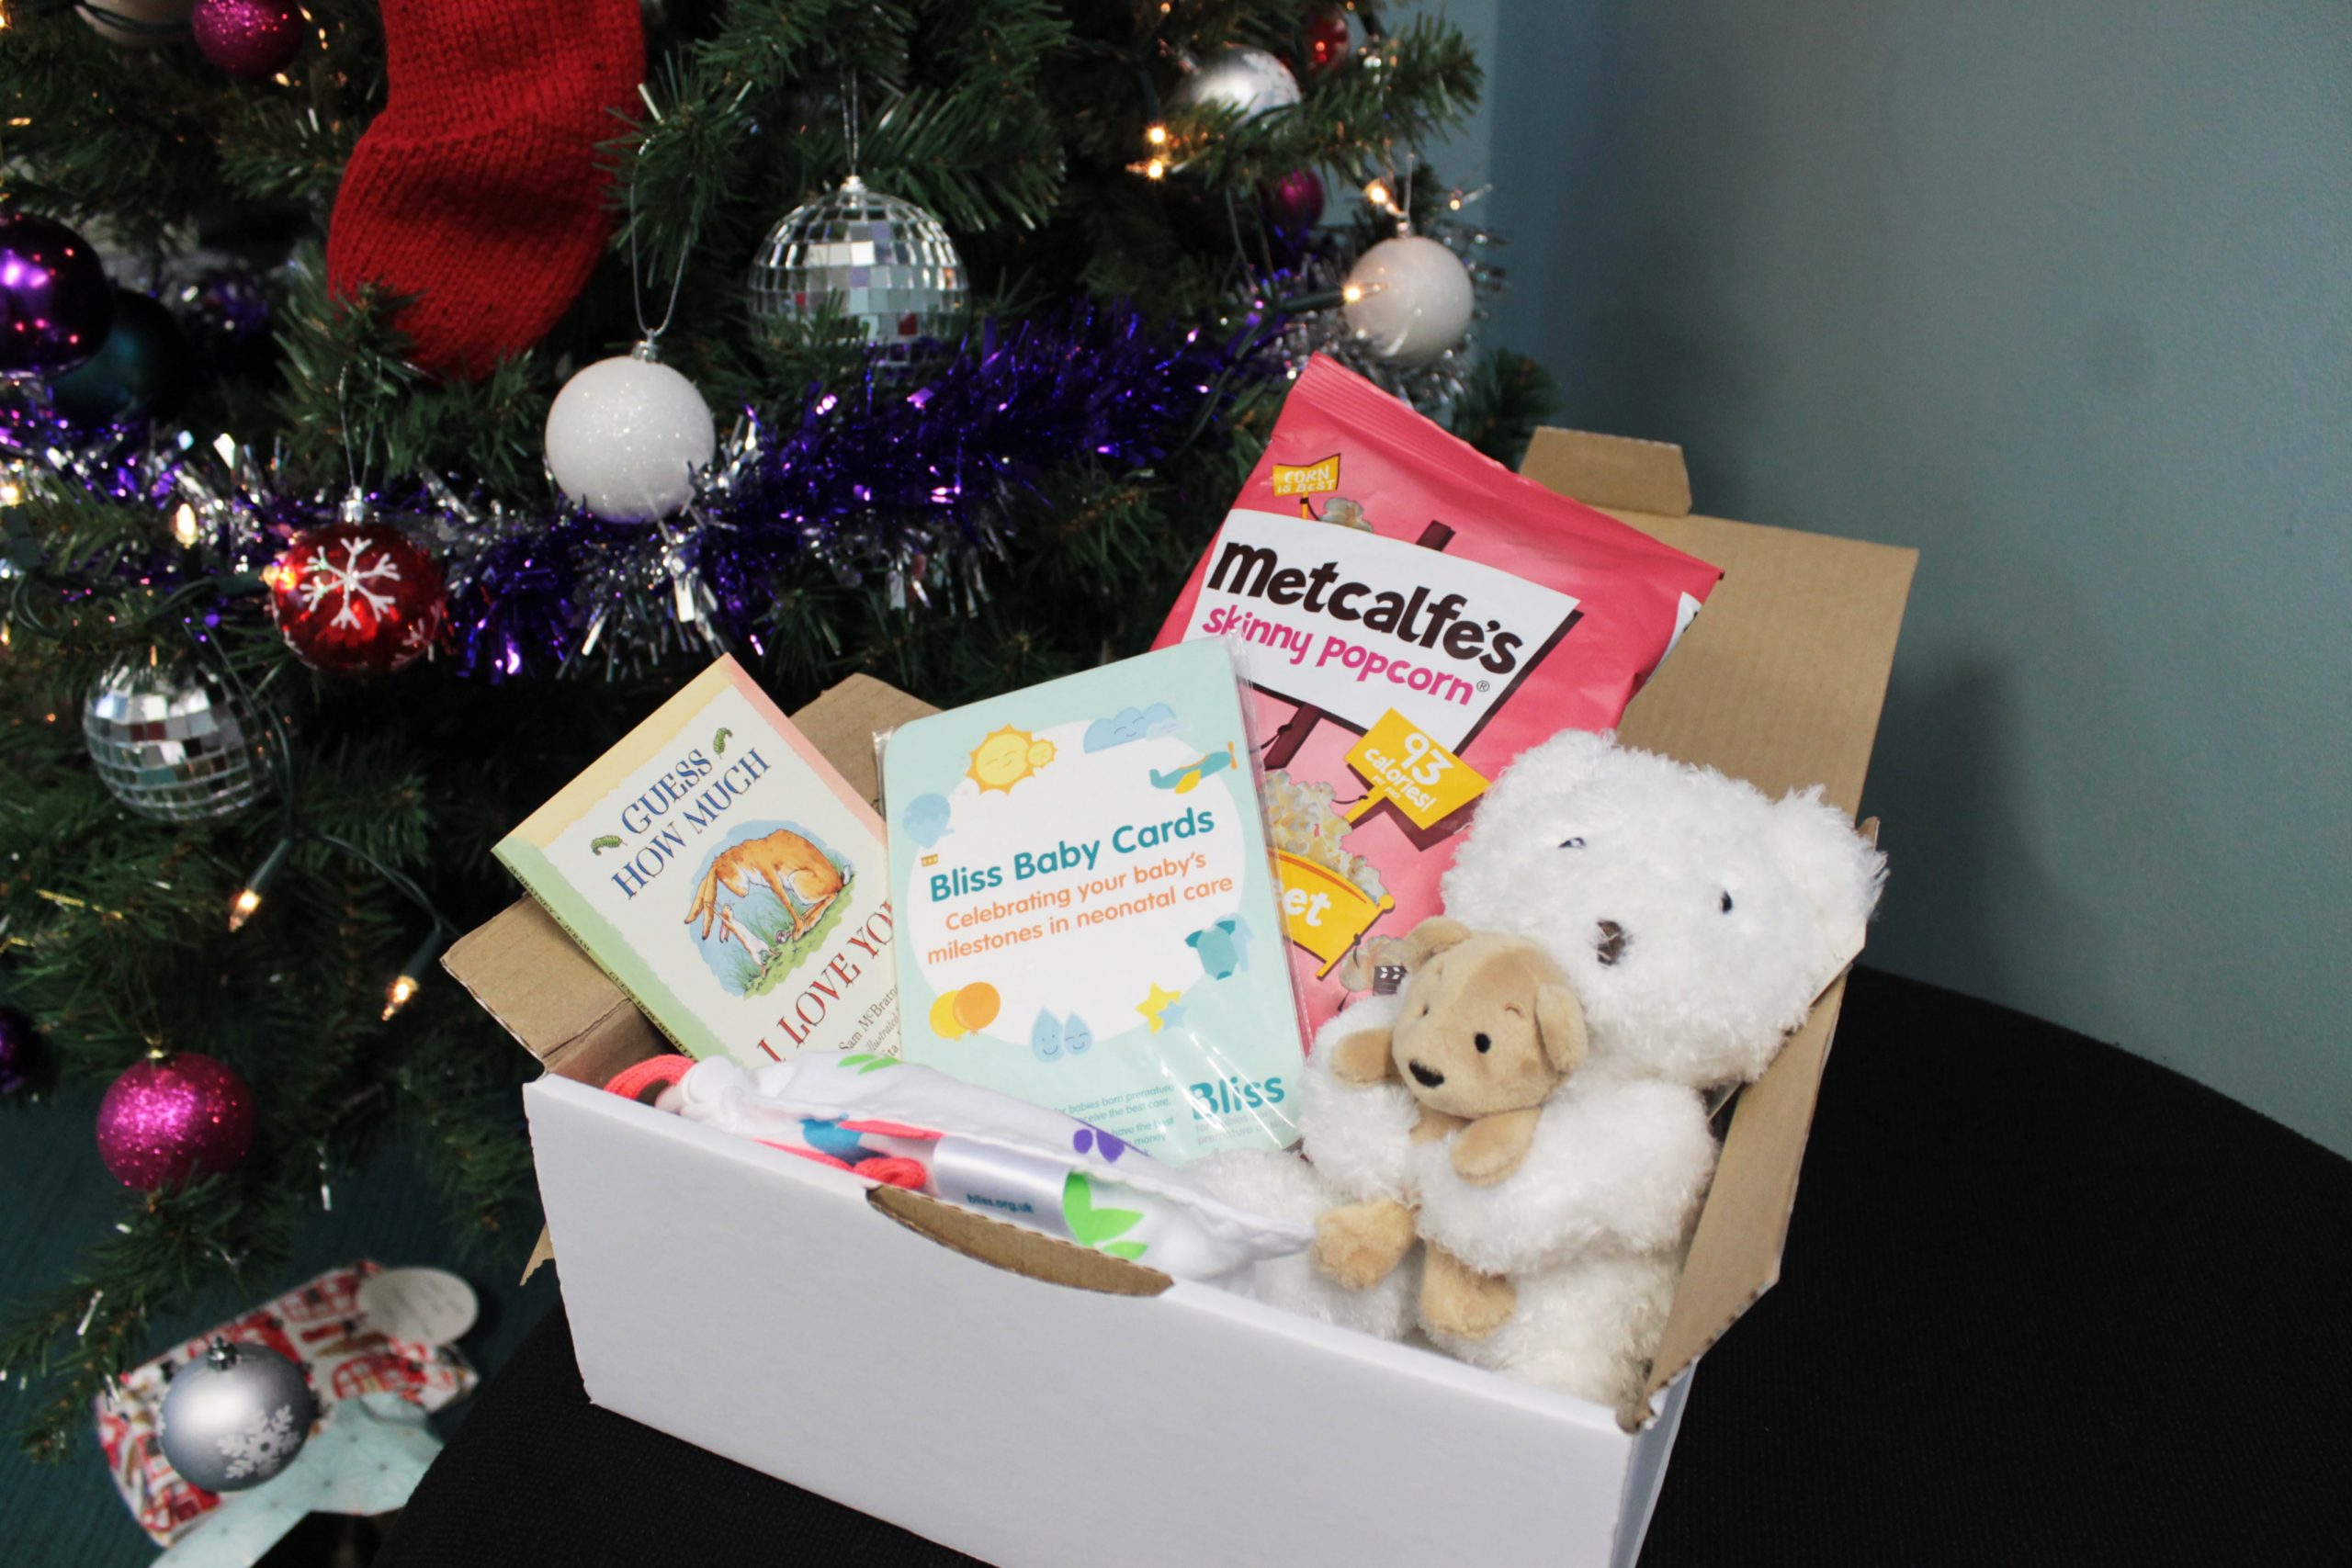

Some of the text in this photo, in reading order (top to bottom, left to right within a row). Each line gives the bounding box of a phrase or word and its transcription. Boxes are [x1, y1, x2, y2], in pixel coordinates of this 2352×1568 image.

[1283, 465, 1329, 484] CORN
[1295, 479, 1336, 493] BEST
[1202, 604, 1314, 665] skinny
[1364, 749, 1438, 813] calories!
[1401, 732, 1454, 786] 93
[621, 749, 713, 835] GUESS
[610, 748, 772, 901] HOW MUCH
[930, 807, 1216, 902] Bliss Baby Cards
[944, 852, 1206, 931] Celebrating your baby's
[927, 877, 1233, 965] milestones in neonatal care
[608, 971, 636, 1000] GUESS
[757, 1037, 786, 1063] I
[776, 952, 862, 1049] LOVE
[838, 1032, 863, 1050] Sam
[1102, 1095, 1124, 1107] born
[1125, 1084, 1175, 1103] premature
[1109, 1106, 1125, 1118] the
[1125, 1101, 1147, 1114] best
[1190, 1076, 1285, 1121] Bliss
[1134, 1134, 1166, 1146] money
[1136, 1120, 1152, 1132] the
